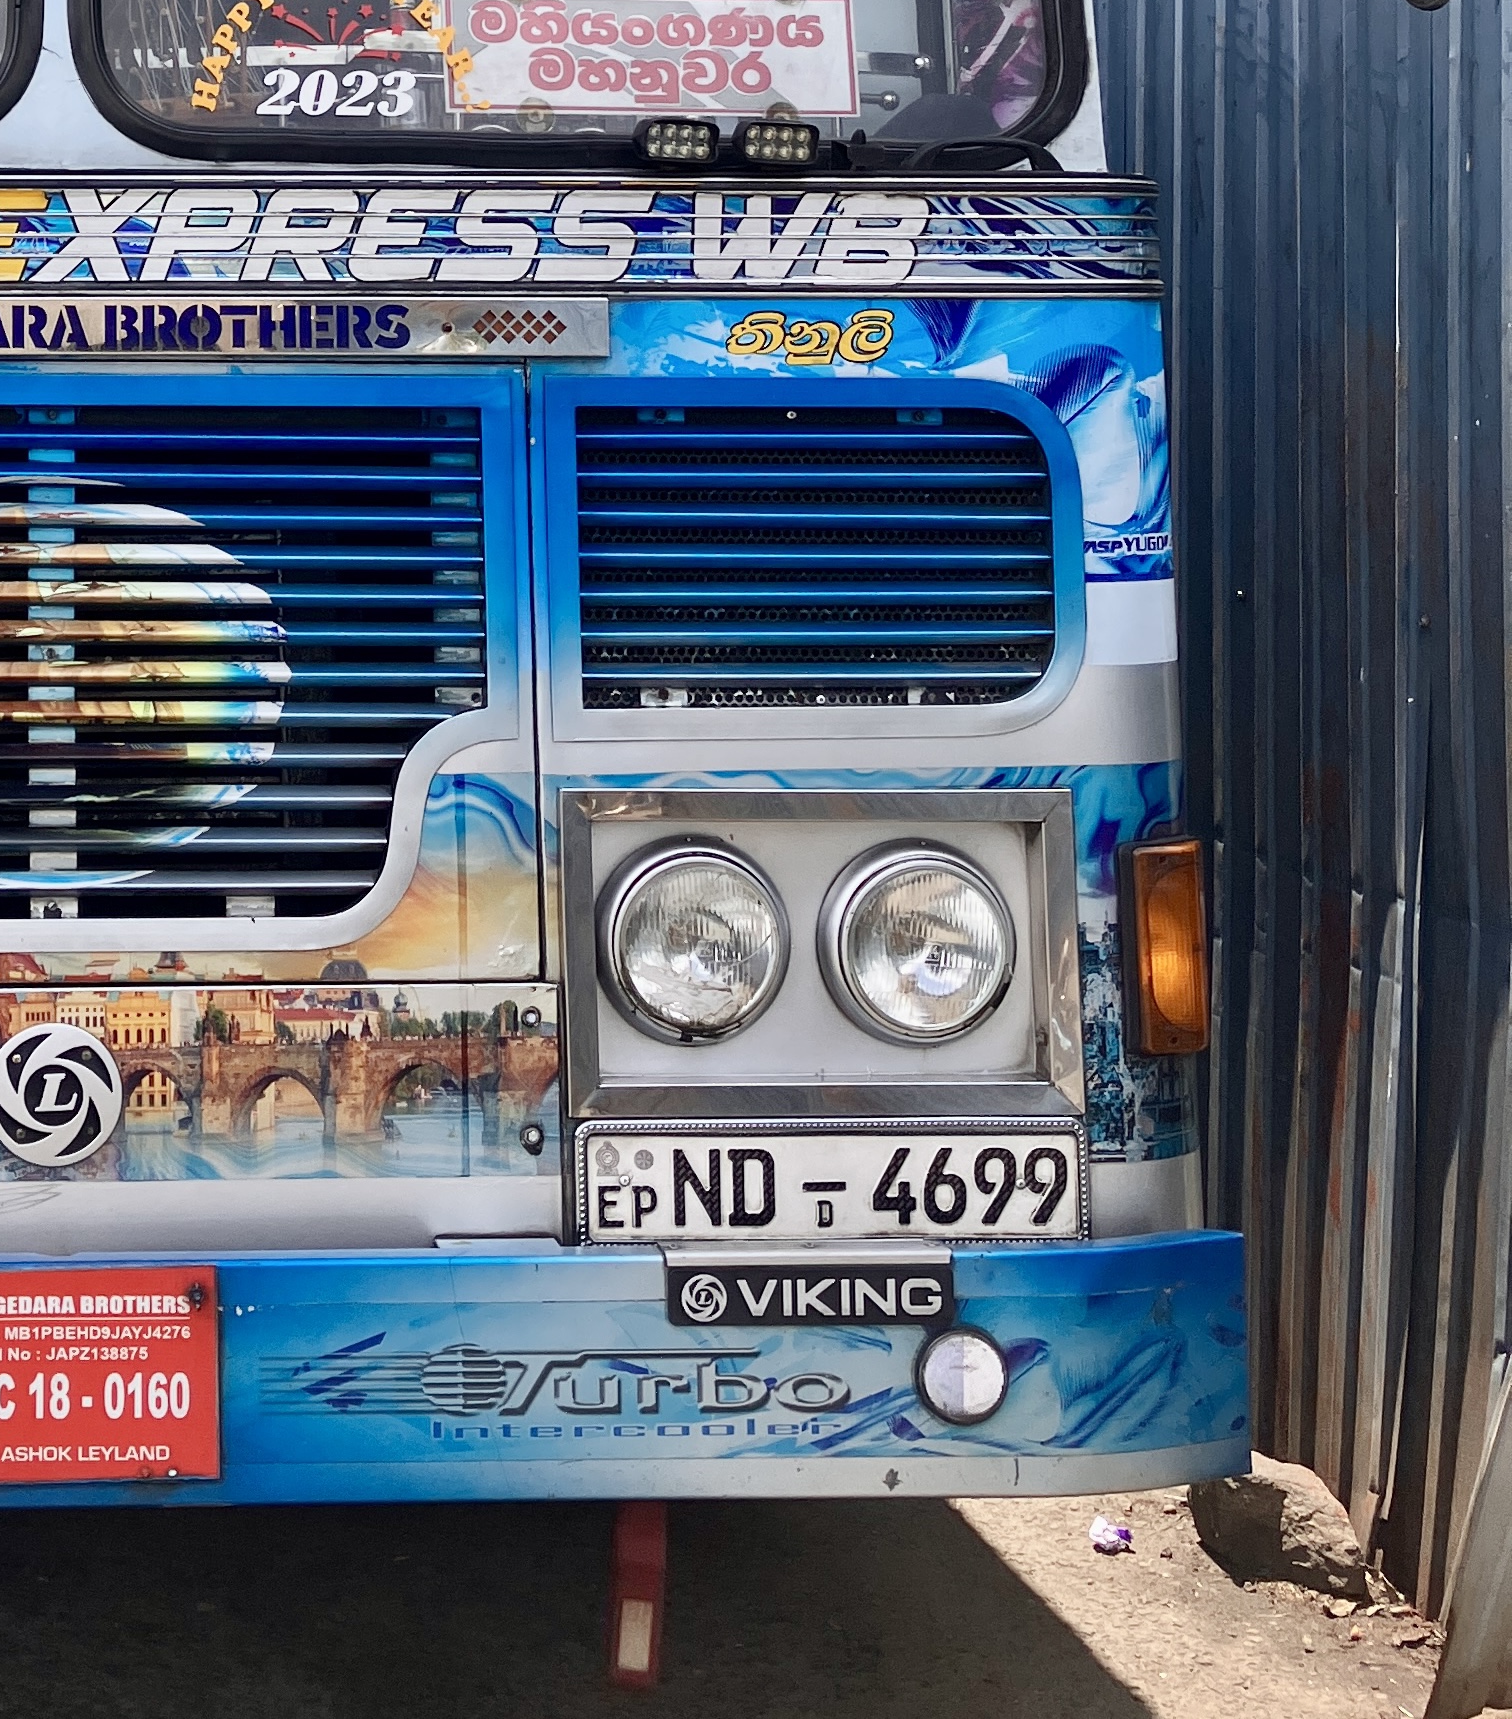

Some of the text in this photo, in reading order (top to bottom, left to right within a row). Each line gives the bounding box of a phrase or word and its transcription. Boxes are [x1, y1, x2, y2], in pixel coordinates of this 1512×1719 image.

[256, 68, 417, 117] 2023
[528, 47, 772, 104] මහනුවර
[691, 191, 932, 285] WB
[104, 303, 411, 351] BROTHERS
[725, 309, 895, 366] තිනුලි
[597, 1184, 658, 1229] EP
[672, 1148, 776, 1227] ND
[871, 1147, 1068, 1226] 4699
[79, 1294, 191, 1315] BROTHERS
[736, 1277, 944, 1317] VIKING
[4, 1325, 192, 1341] MB1PBEHD9JAYJ4276
[7, 1347, 31, 1361] No
[45, 1346, 149, 1361] JAPZ138875
[28, 1372, 70, 1419] 18
[103, 1371, 190, 1420] 0160
[493, 1346, 852, 1417] Turbo
[431, 1417, 842, 1441] Intercooler
[0, 1446, 72, 1462] ASHOK
[78, 1445, 171, 1462] LEYLAND
